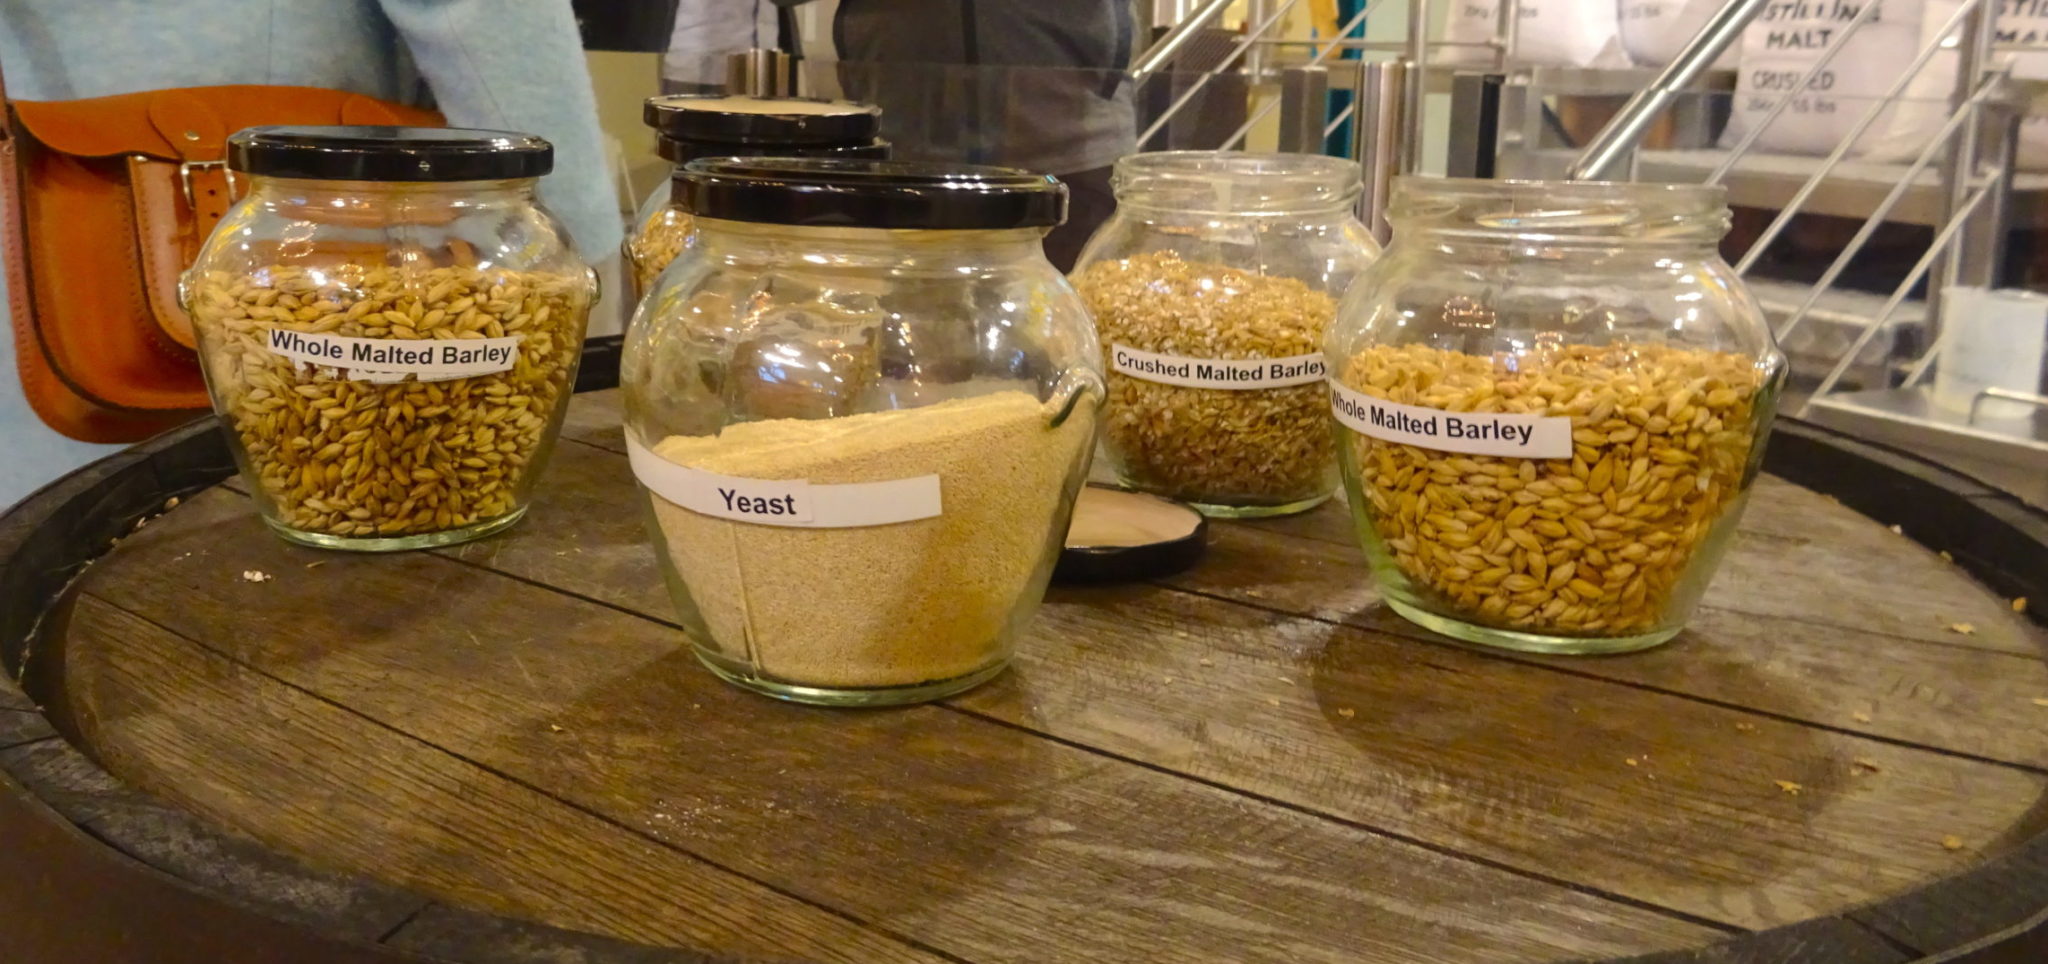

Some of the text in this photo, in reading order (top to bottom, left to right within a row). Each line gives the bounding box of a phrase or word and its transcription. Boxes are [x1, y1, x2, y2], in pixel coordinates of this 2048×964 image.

[1766, 28, 1832, 49] MALT
[1752, 70, 1835, 91] CRUSED
[271, 328, 512, 365] Whole Malted Barley
[1117, 351, 1325, 381] Crushed Malted Barley
[1331, 388, 1533, 446] Whole Malted Barley
[718, 488, 797, 515] Yeast
